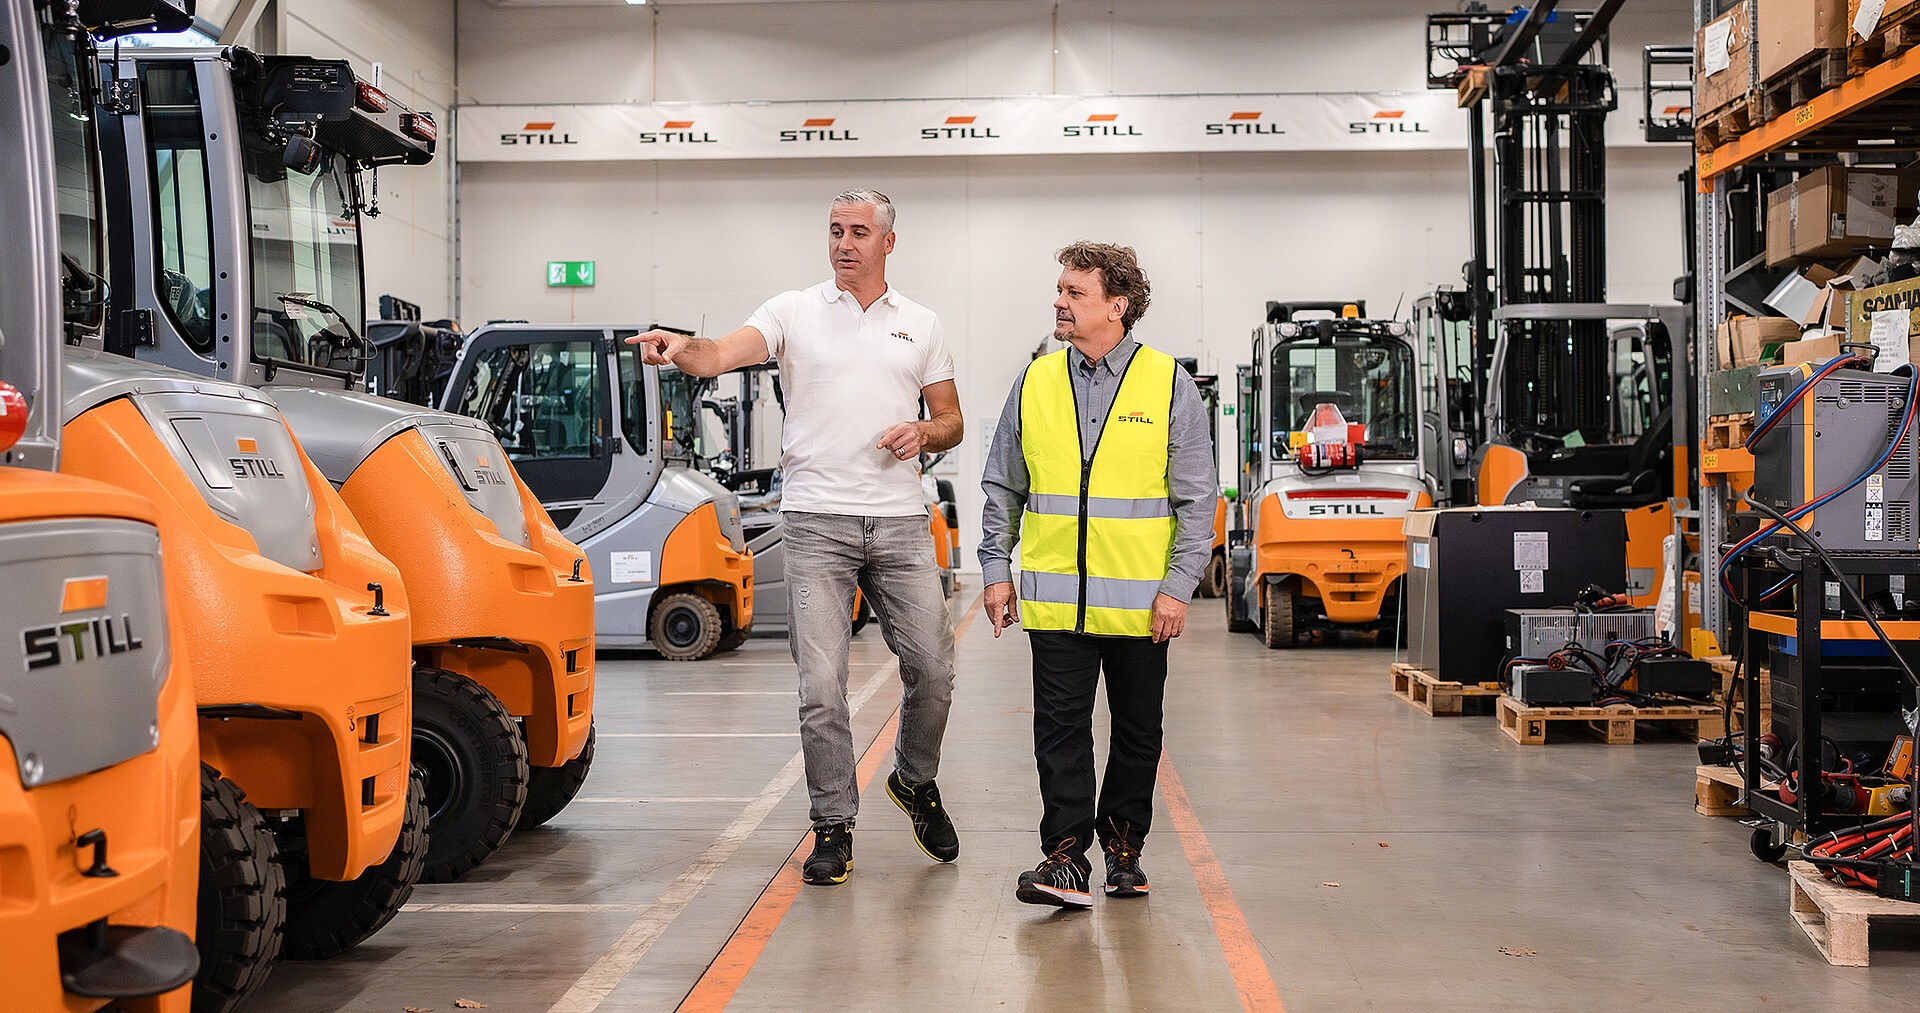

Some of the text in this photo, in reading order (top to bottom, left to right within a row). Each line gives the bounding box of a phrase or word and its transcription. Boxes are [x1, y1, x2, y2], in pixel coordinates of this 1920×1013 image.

[1064, 126, 1141, 136] STILL
[1207, 124, 1285, 134] STILL
[1350, 123, 1429, 133] STILL
[641, 133, 716, 143] STILL
[781, 131, 858, 141] STILL
[922, 128, 999, 139] STILL
[501, 134, 577, 145] STILL
[891, 333, 915, 343] STILL
[1118, 416, 1153, 424] STILL
[229, 458, 285, 479] STILL
[474, 470, 506, 485] STILL
[1309, 504, 1384, 515] STILL
[20, 613, 143, 671] STILL
